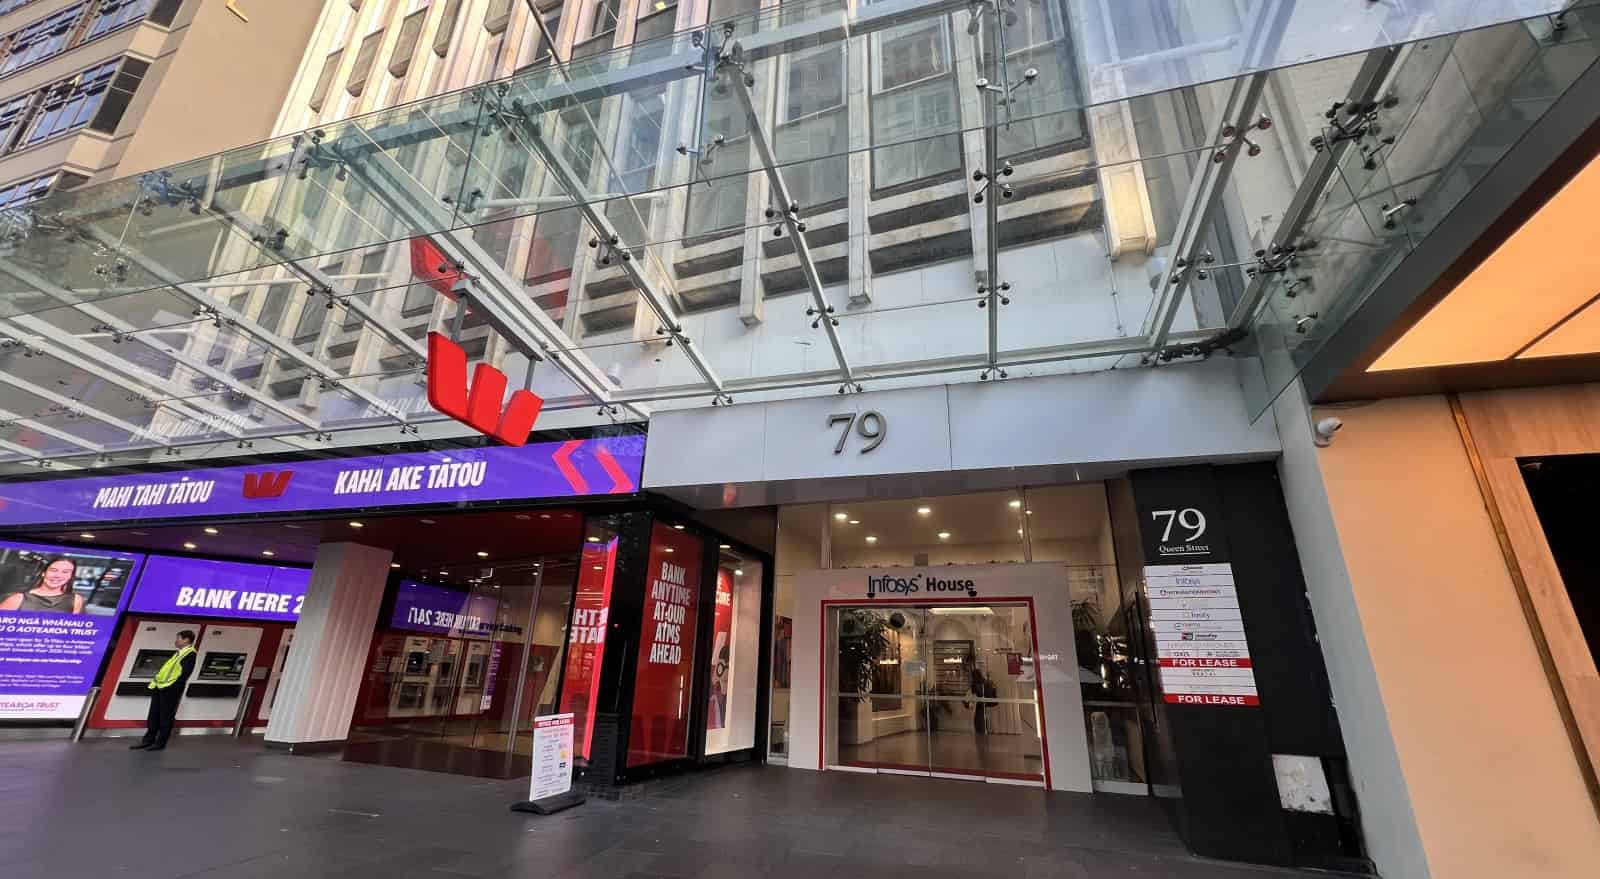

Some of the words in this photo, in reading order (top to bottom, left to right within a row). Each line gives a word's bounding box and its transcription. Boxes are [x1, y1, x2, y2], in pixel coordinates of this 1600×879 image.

[827, 410, 887, 455] 79
[334, 469, 383, 494] KAHA
[386, 466, 426, 491] AKE
[427, 457, 487, 488] TĀTOU
[93, 486, 134, 508] MAHI
[132, 484, 167, 506] TAHI
[166, 476, 215, 504] TĀTOU
[1152, 508, 1206, 542] 79
[1159, 544, 1185, 554] Queen
[1186, 544, 1209, 553] Street
[661, 561, 686, 585] BANK
[651, 580, 692, 607] ANYTIME
[868, 575, 921, 596] Infosys
[926, 577, 975, 592] House
[176, 587, 236, 610] BANK
[238, 591, 292, 613] HERE
[292, 596, 304, 614] 2
[653, 601, 667, 622] AT
[667, 604, 685, 625] OUR
[71, 628, 99, 636] TRUST
[655, 623, 681, 644] ATMS
[649, 641, 681, 665] AHEAD
[1172, 659, 1197, 667] FOR
[1199, 659, 1238, 667] LEASE
[1177, 695, 1202, 704] FOR
[1205, 695, 1245, 705] LEASE
